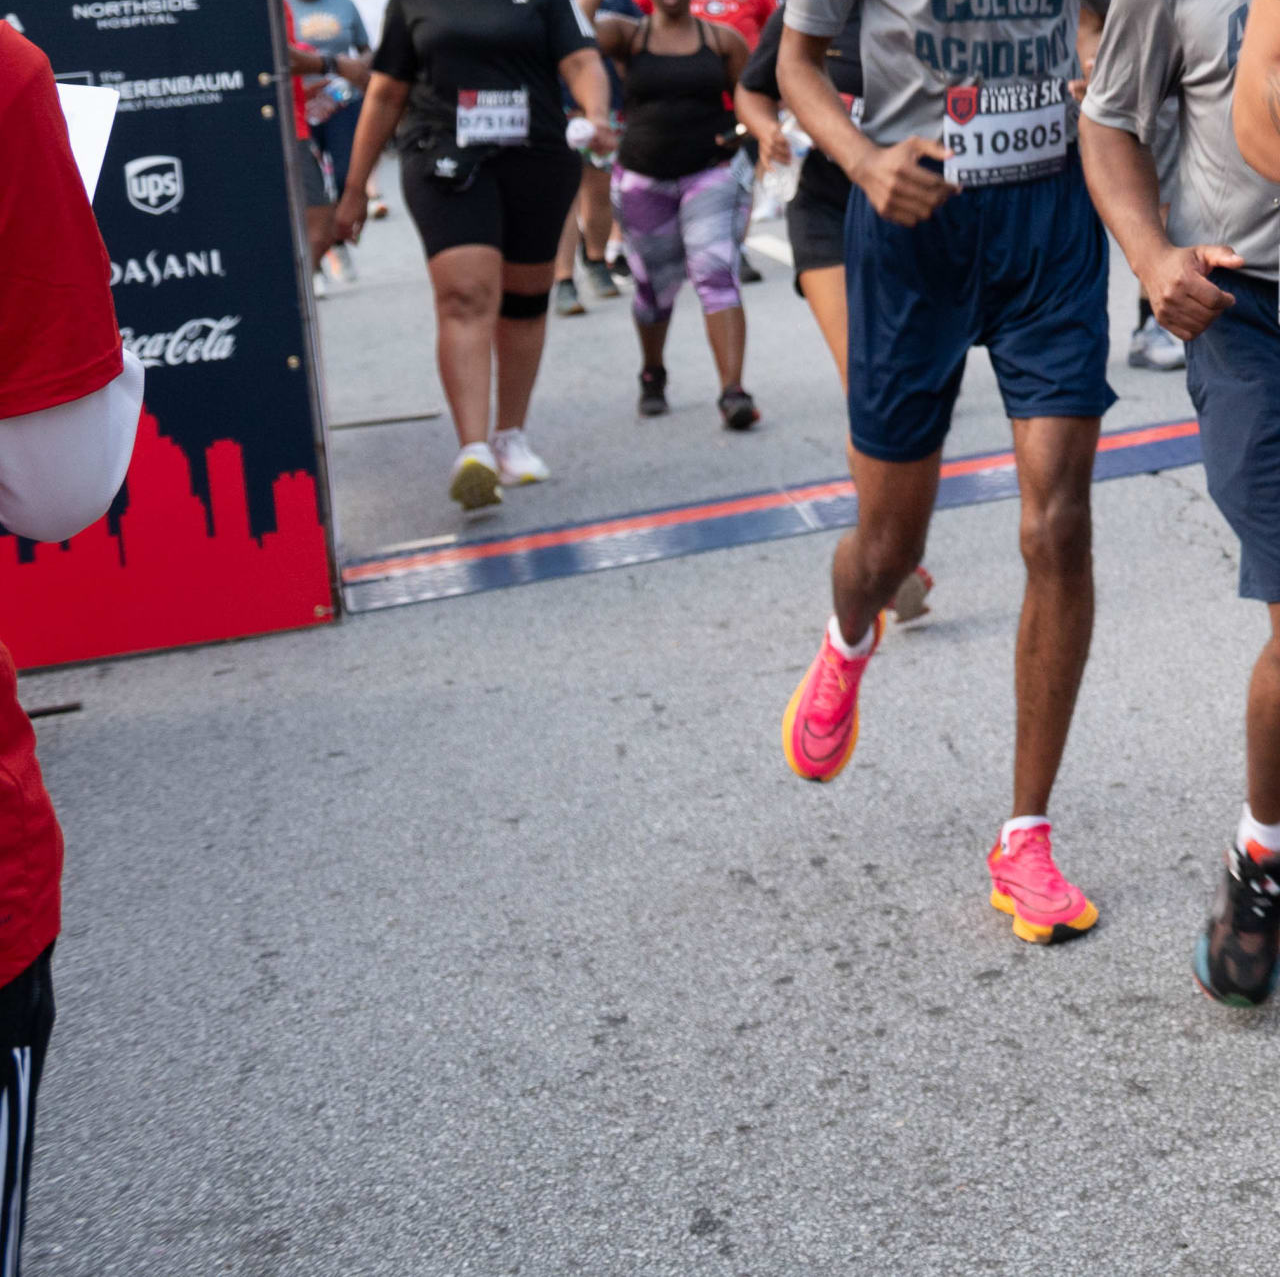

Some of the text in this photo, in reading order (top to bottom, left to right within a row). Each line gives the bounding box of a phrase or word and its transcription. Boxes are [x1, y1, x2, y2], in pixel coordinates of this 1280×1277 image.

[97, 12, 178, 29] HOSPITAL
[915, 21, 1070, 78] ACADEMY
[981, 78, 1063, 113] FINEST 5K
[948, 120, 1062, 157] B10805
[132, 173, 177, 207] ups
